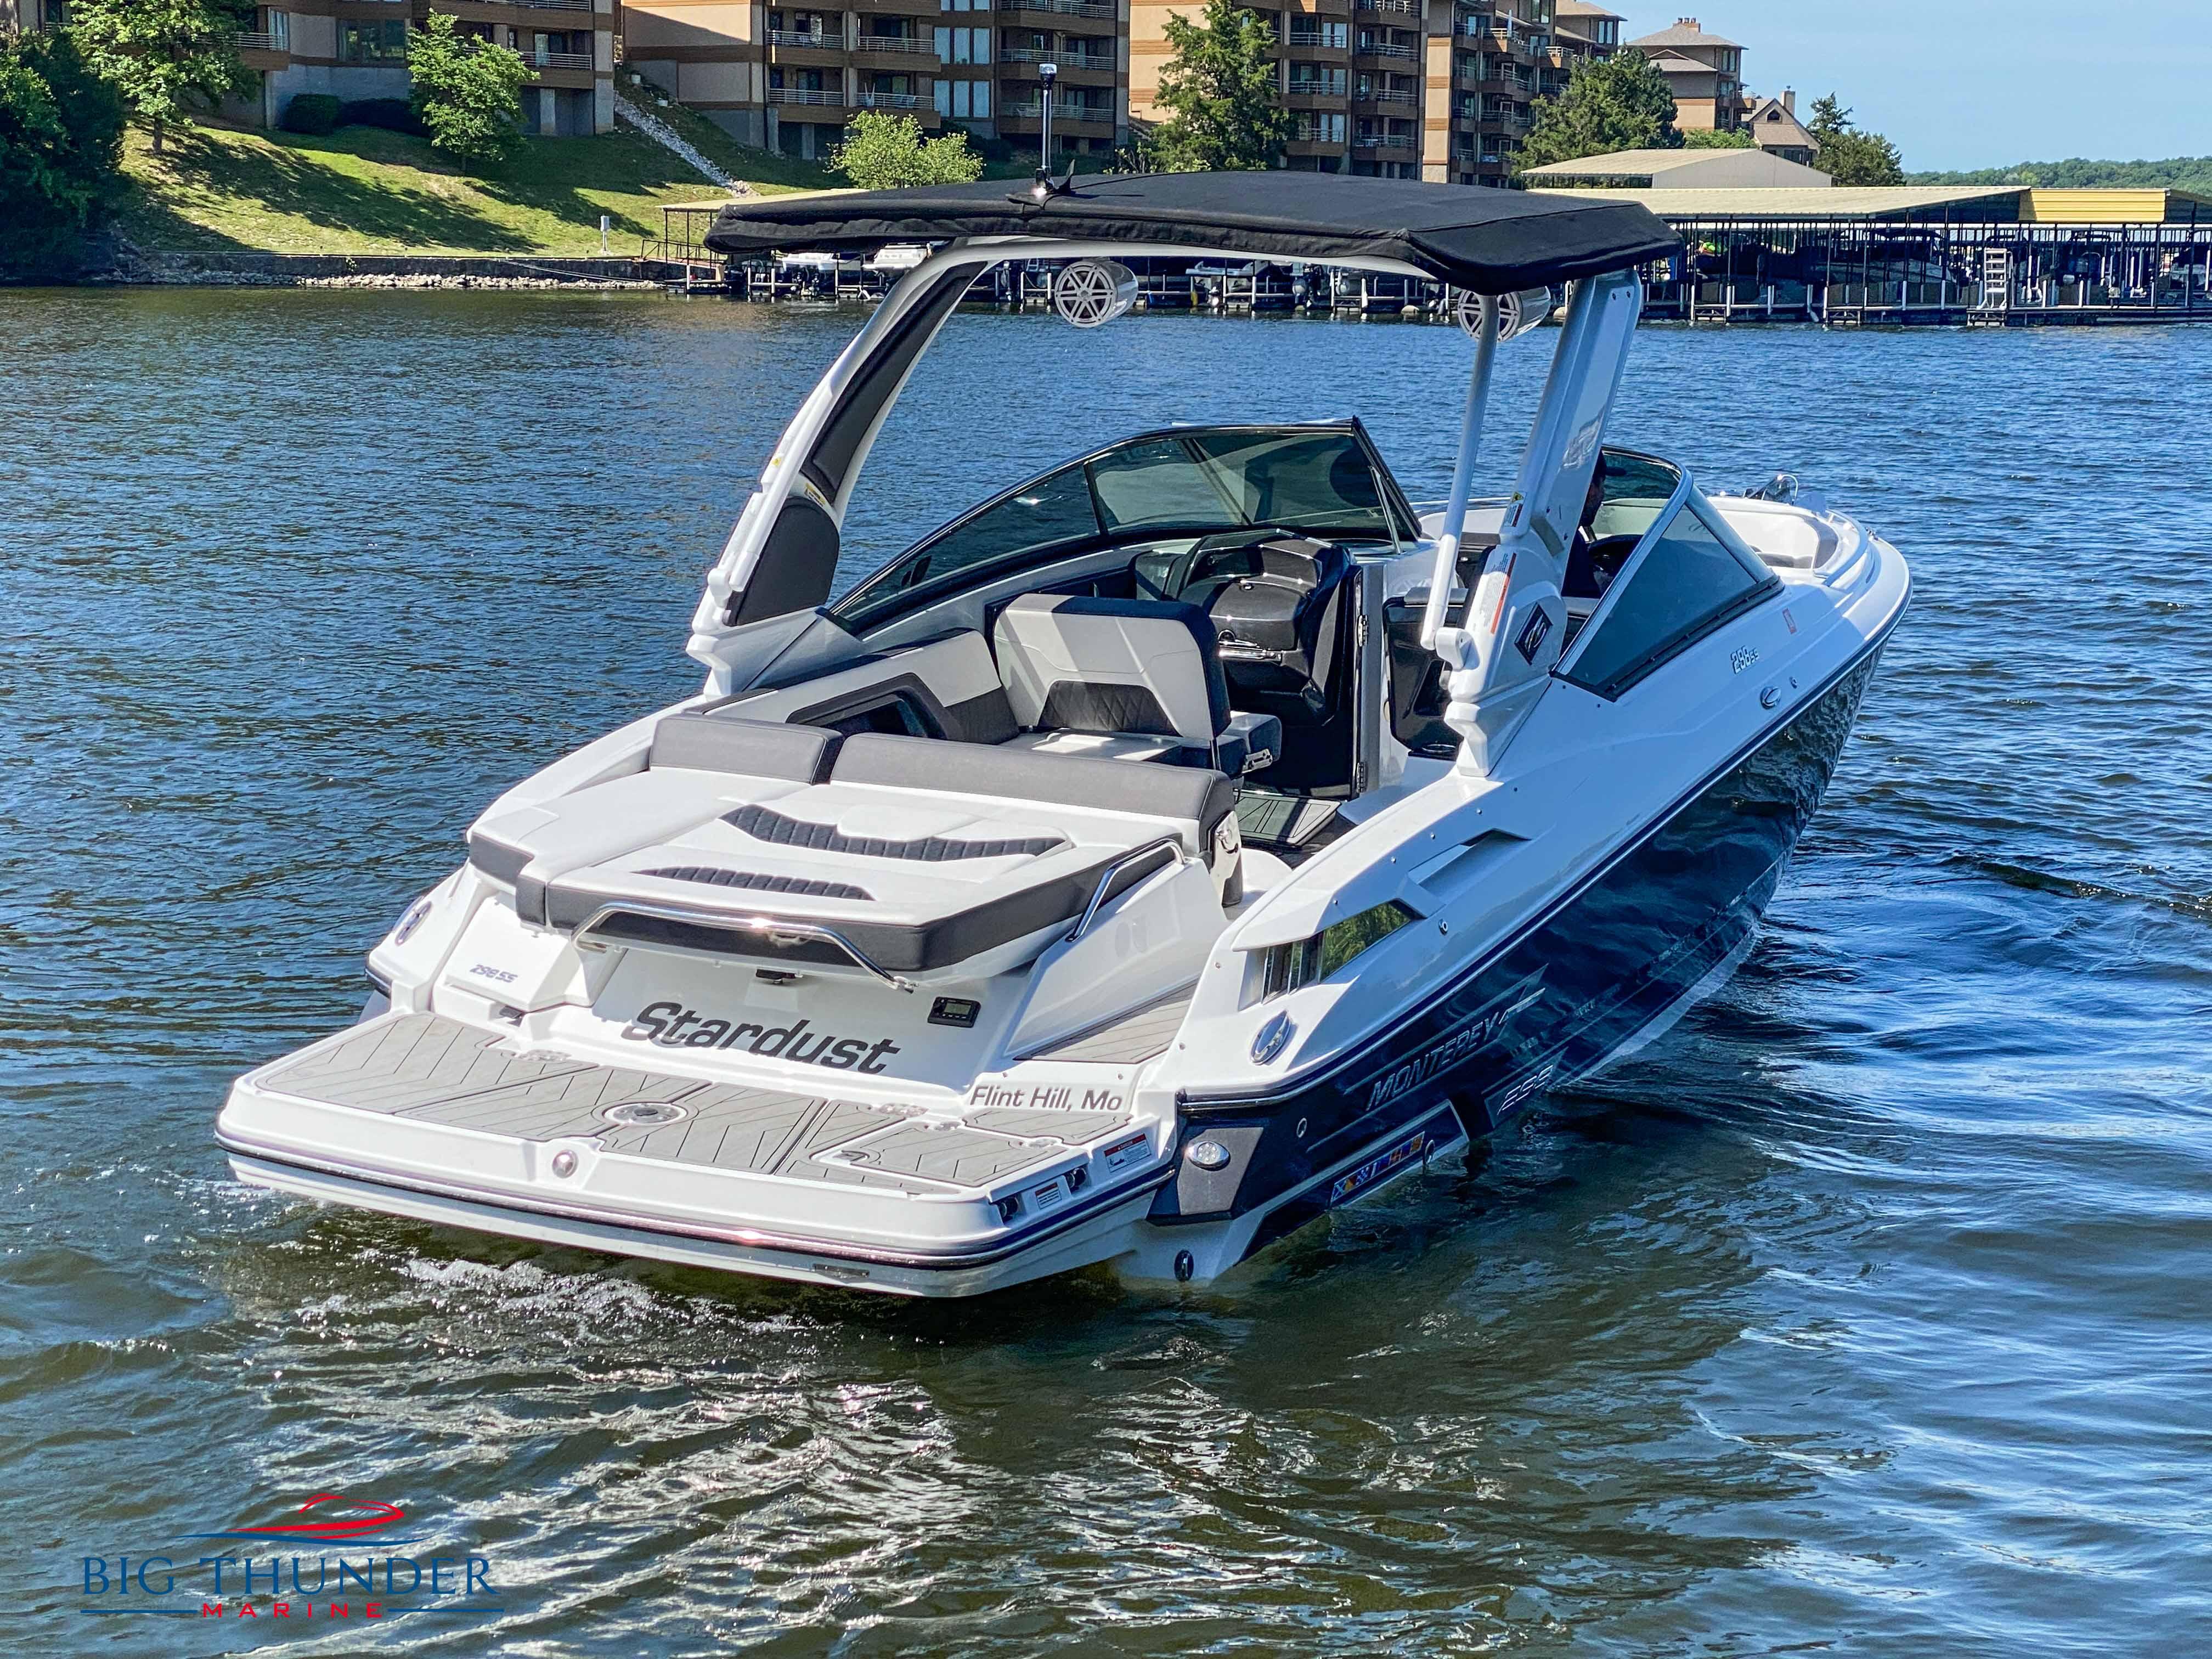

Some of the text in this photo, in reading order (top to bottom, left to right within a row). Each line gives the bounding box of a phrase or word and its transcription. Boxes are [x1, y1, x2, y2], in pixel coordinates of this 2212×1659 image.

[620, 1002, 901, 1074] Stardust
[1365, 1011, 1499, 1111] MONTEREY
[969, 1086, 1122, 1111] Flint Hill, Mo
